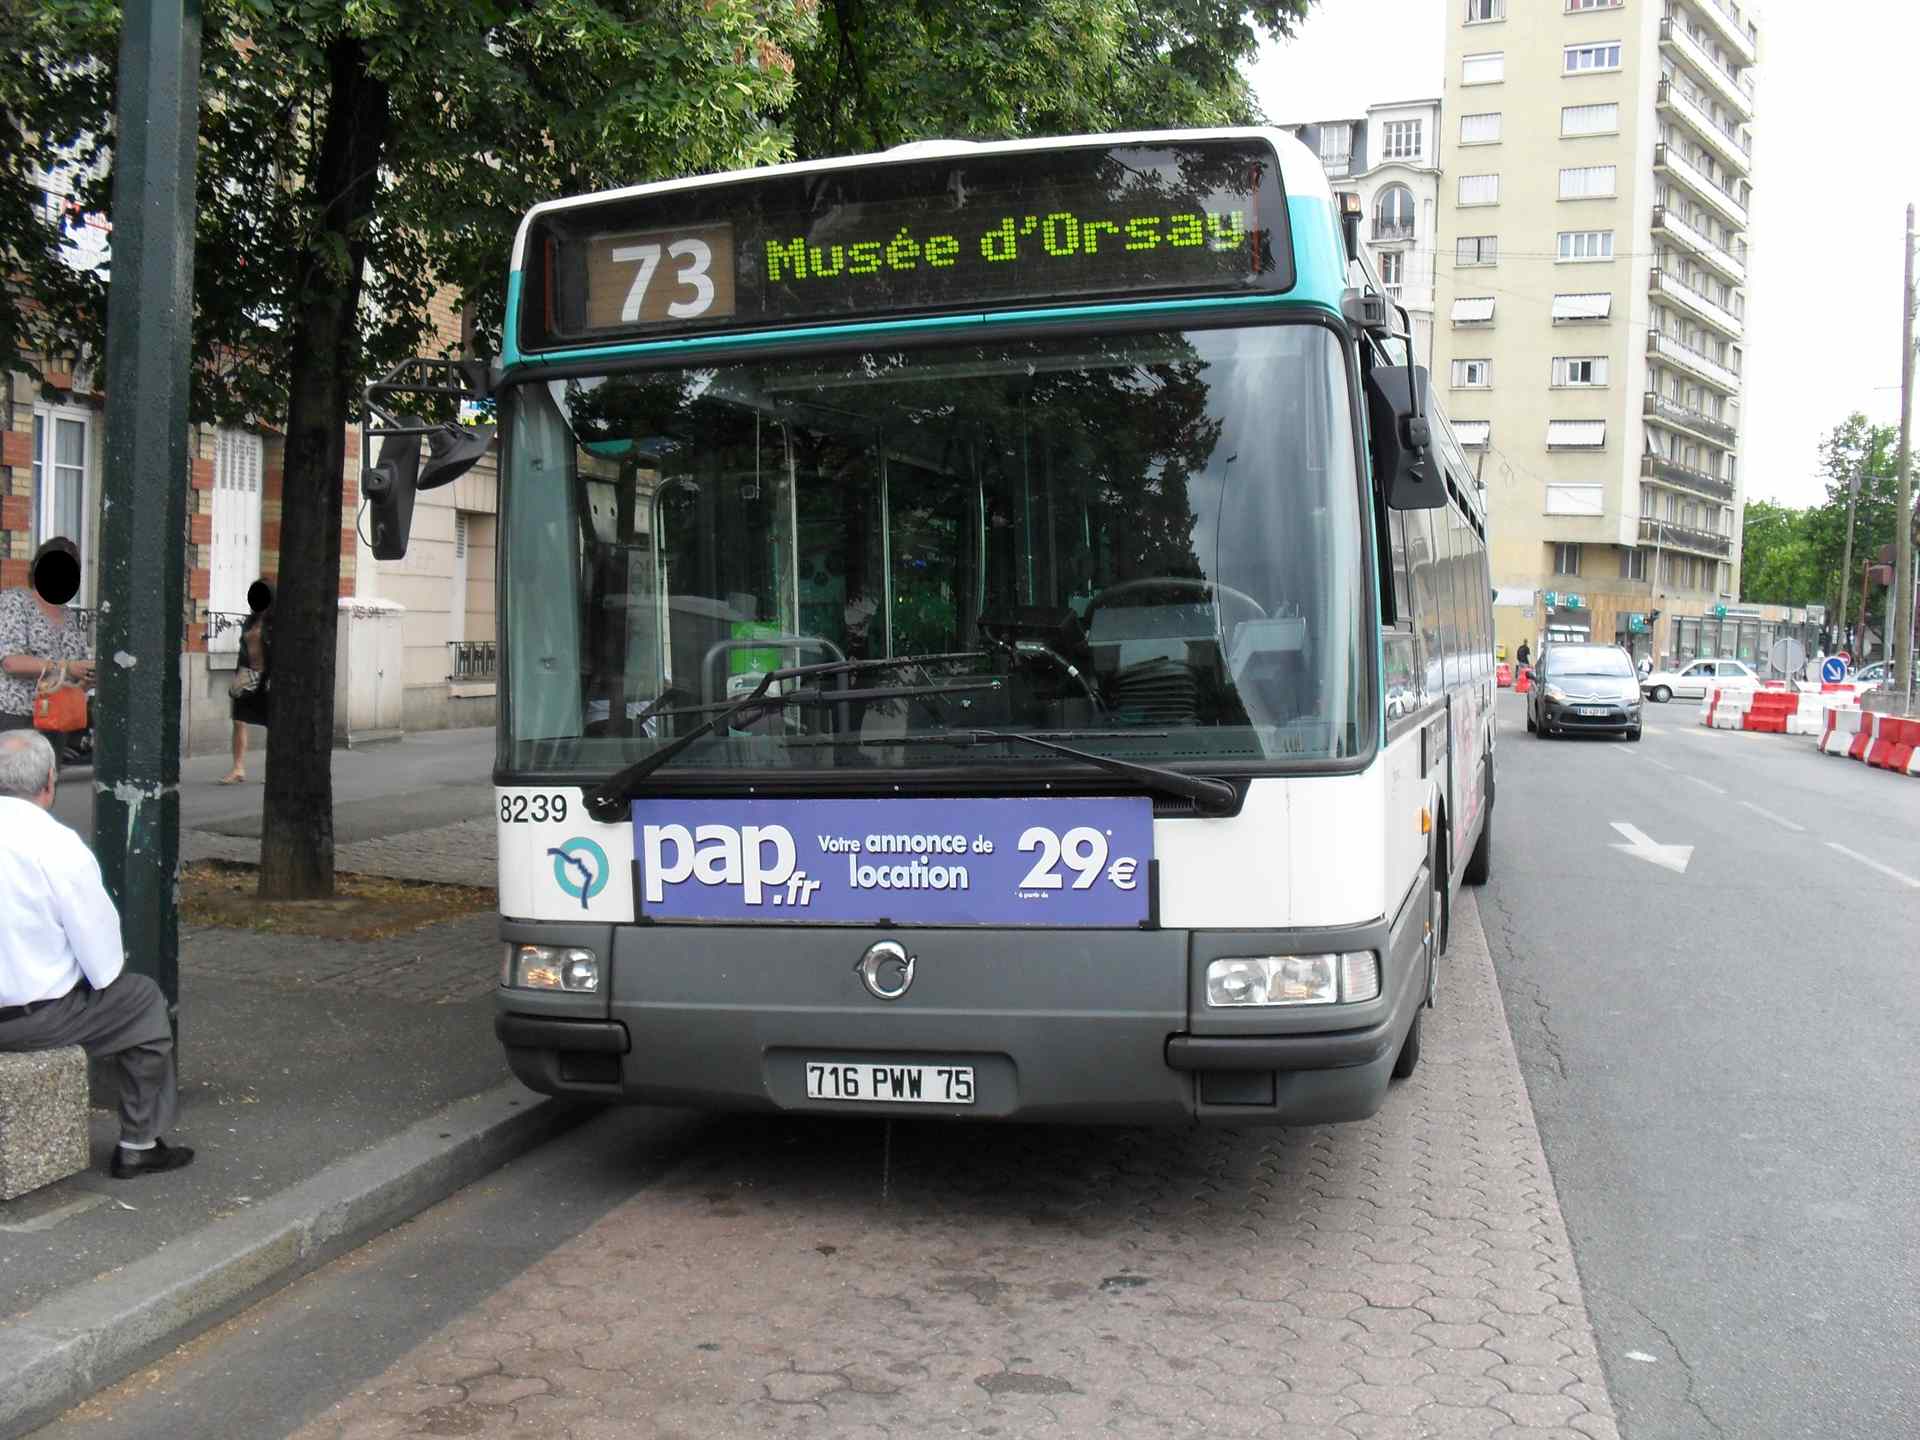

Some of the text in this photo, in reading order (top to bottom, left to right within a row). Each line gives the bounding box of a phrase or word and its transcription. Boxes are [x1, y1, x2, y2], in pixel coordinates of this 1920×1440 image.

[612, 211, 1244, 322] 73 Musée d'Orsay
[500, 794, 567, 823] 8239
[818, 832, 994, 855] Votre annonce de
[849, 854, 969, 890] location
[809, 1066, 972, 1100] 716 PWW 75
